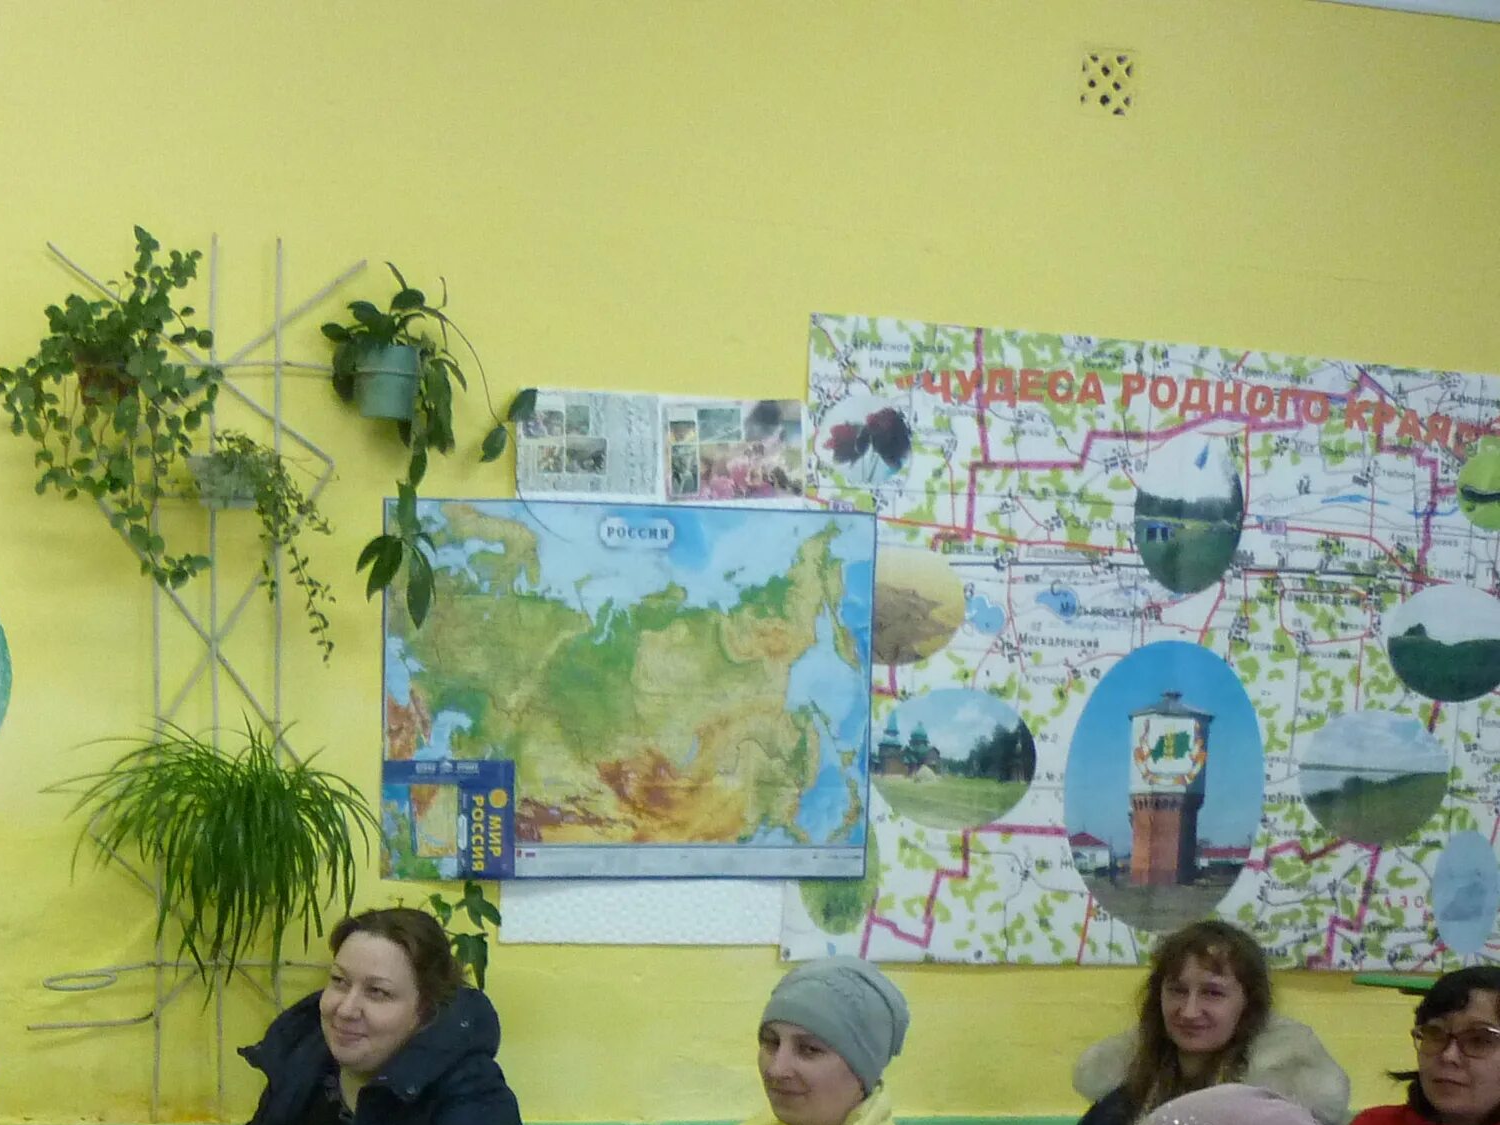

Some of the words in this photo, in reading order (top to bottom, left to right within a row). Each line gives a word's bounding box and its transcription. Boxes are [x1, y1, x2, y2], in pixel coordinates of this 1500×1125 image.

[1121, 373, 1330, 424] РОДНОГО
[606, 526, 670, 540] РОССИЯ
[471, 794, 485, 871] РОССИЯ
[488, 815, 502, 857] МИР
